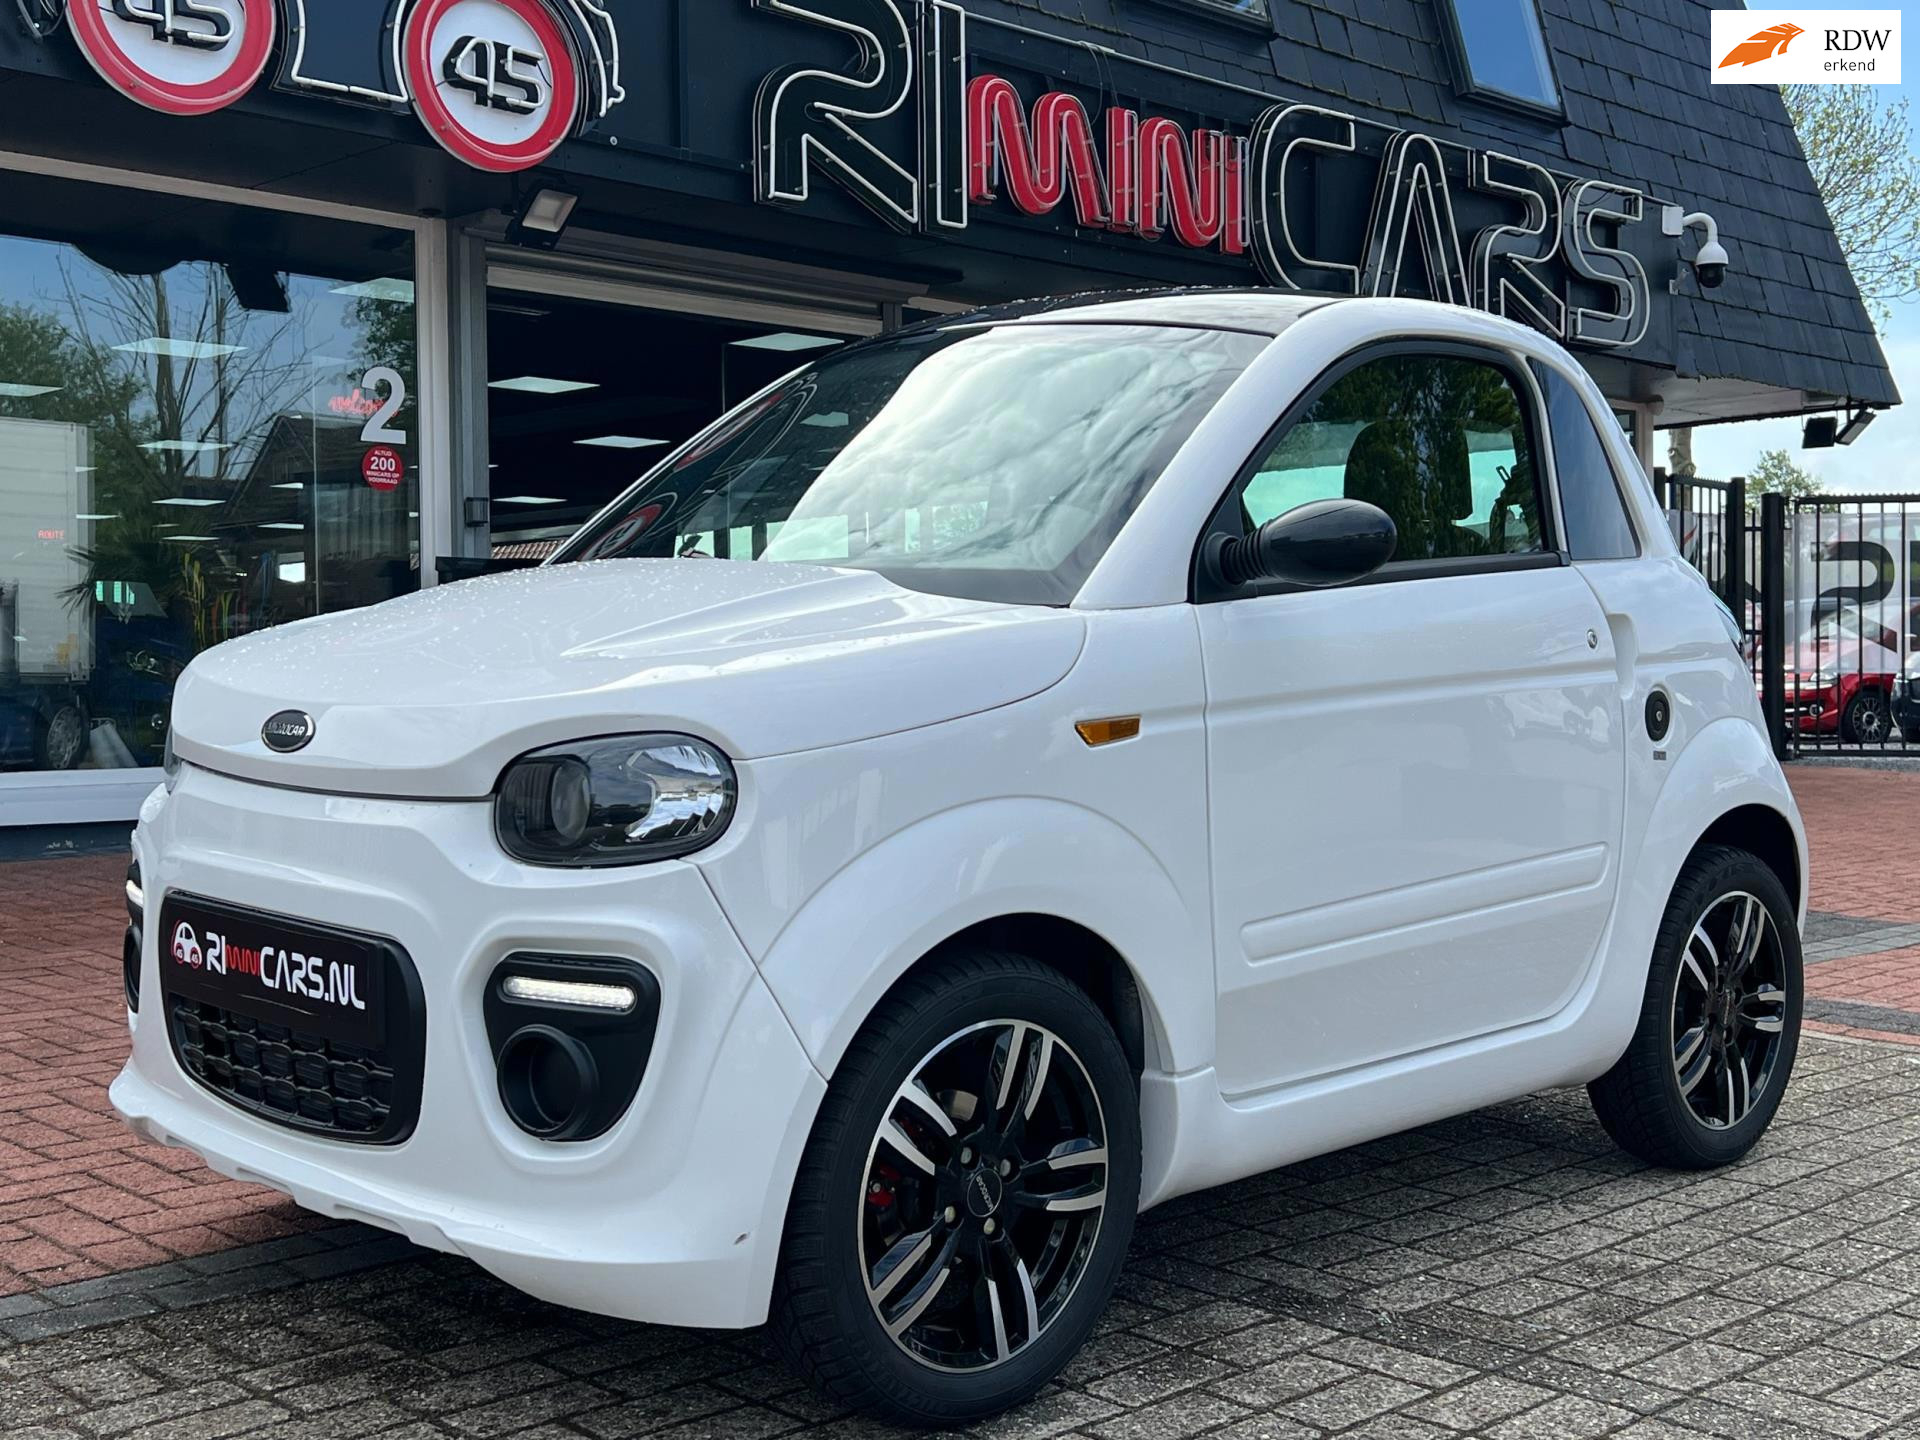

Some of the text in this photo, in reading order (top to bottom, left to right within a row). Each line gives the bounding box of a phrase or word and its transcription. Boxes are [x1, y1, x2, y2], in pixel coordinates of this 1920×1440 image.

[443, 35, 546, 115] 45
[361, 366, 406, 444] 2
[370, 457, 396, 472] 200
